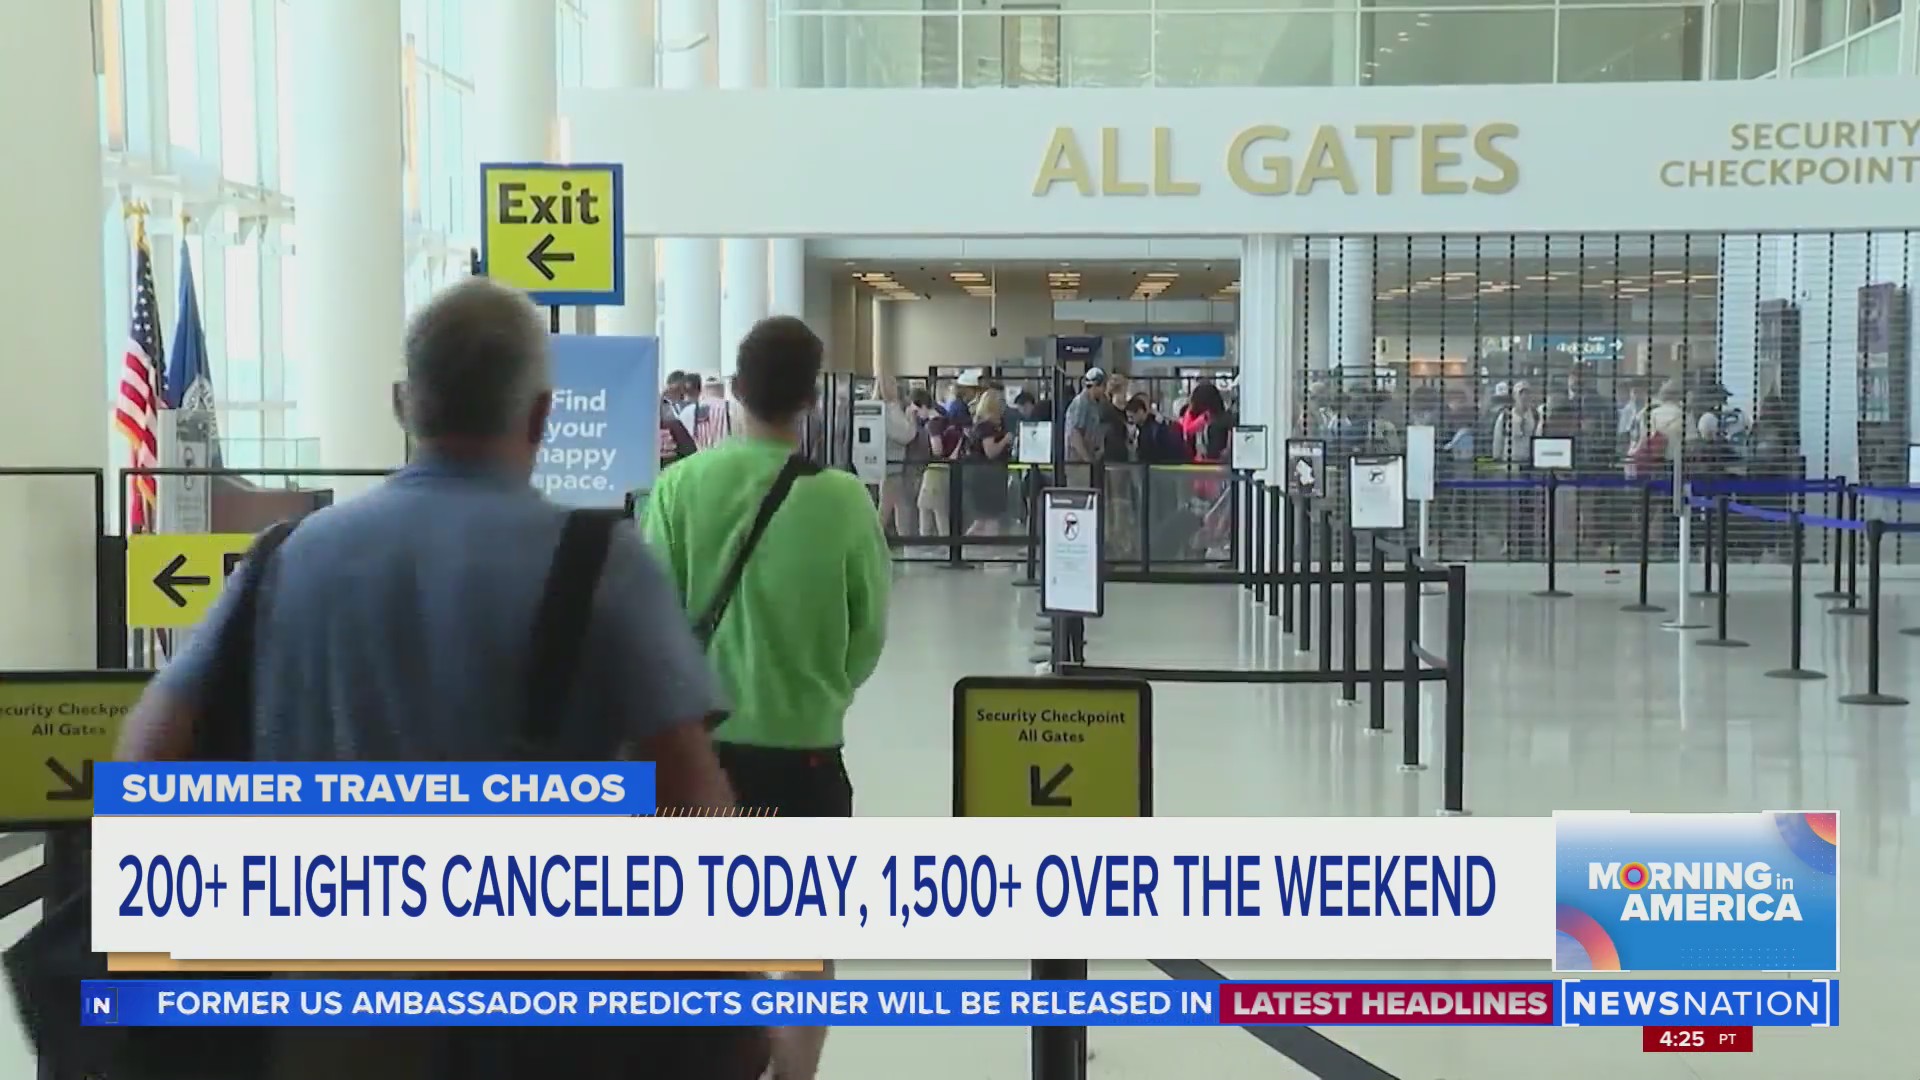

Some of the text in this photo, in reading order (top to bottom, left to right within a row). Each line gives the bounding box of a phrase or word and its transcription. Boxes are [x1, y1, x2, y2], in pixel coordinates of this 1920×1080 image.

[1730, 119, 1920, 151] SECURITY
[1032, 123, 1520, 196] ALL GATES
[1659, 156, 1920, 188] CHECKPOINT
[499, 180, 600, 225] Exit
[551, 388, 606, 411] Find
[546, 421, 608, 444] your
[976, 708, 1126, 727] Security Checkpoint
[32, 723, 107, 736] All Gates
[1018, 729, 1085, 743] All Gates
